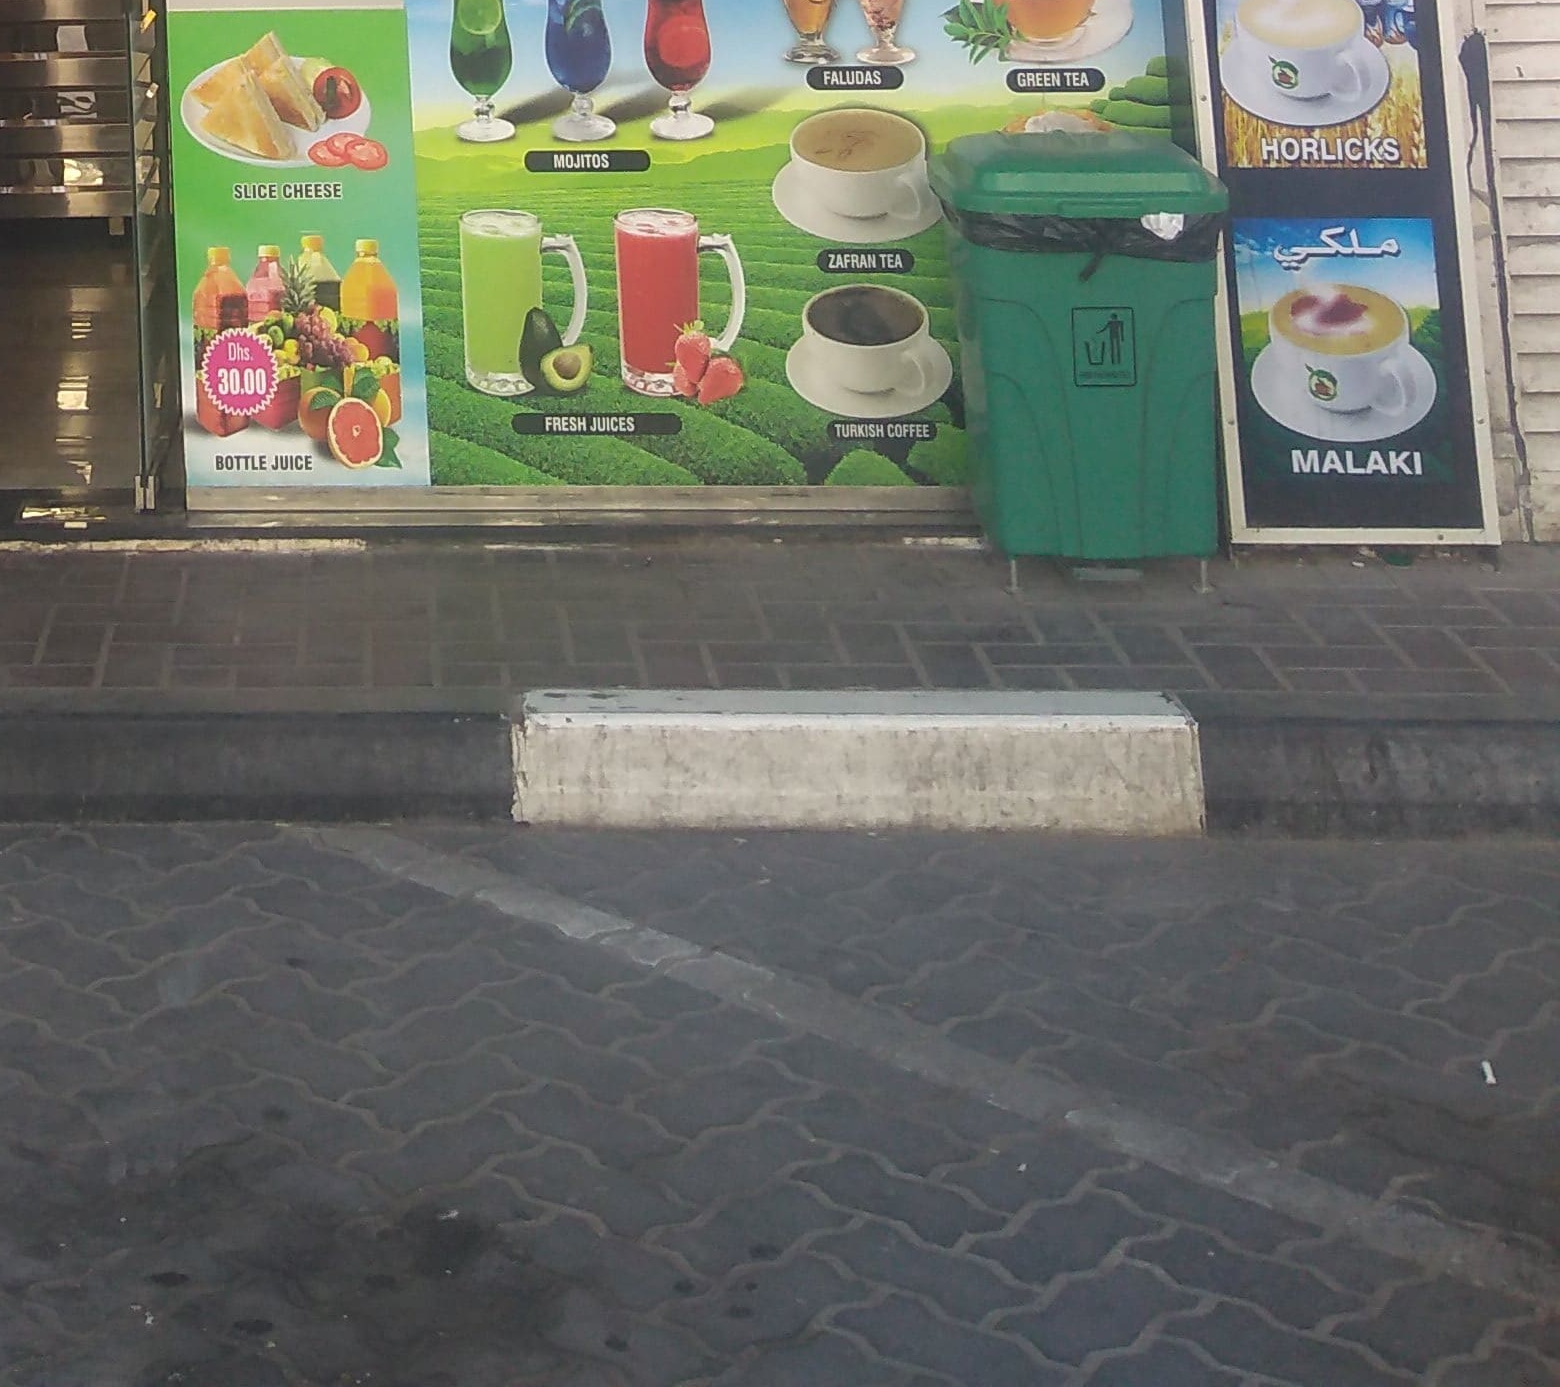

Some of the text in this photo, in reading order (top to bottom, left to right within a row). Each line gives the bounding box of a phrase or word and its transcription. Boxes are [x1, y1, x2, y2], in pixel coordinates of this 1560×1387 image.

[823, 70, 881, 86] FALUDAS
[1017, 70, 1089, 89] GREEN TEA
[1260, 137, 1400, 162] HORLICKS
[553, 153, 610, 169] MOJITOS
[233, 182, 342, 199] SLICE CHEESE
[1273, 226, 1401, 270] ملكي
[827, 253, 904, 270] ZAFRAN TEA
[227, 341, 254, 362] Dhs.
[217, 368, 267, 396] 30.00
[544, 416, 635, 432] FRESH JUICES
[834, 422, 930, 439] TURKISH COFFEE
[215, 454, 313, 472] BOTTLE JUICE
[1291, 448, 1423, 476] MALAKI
